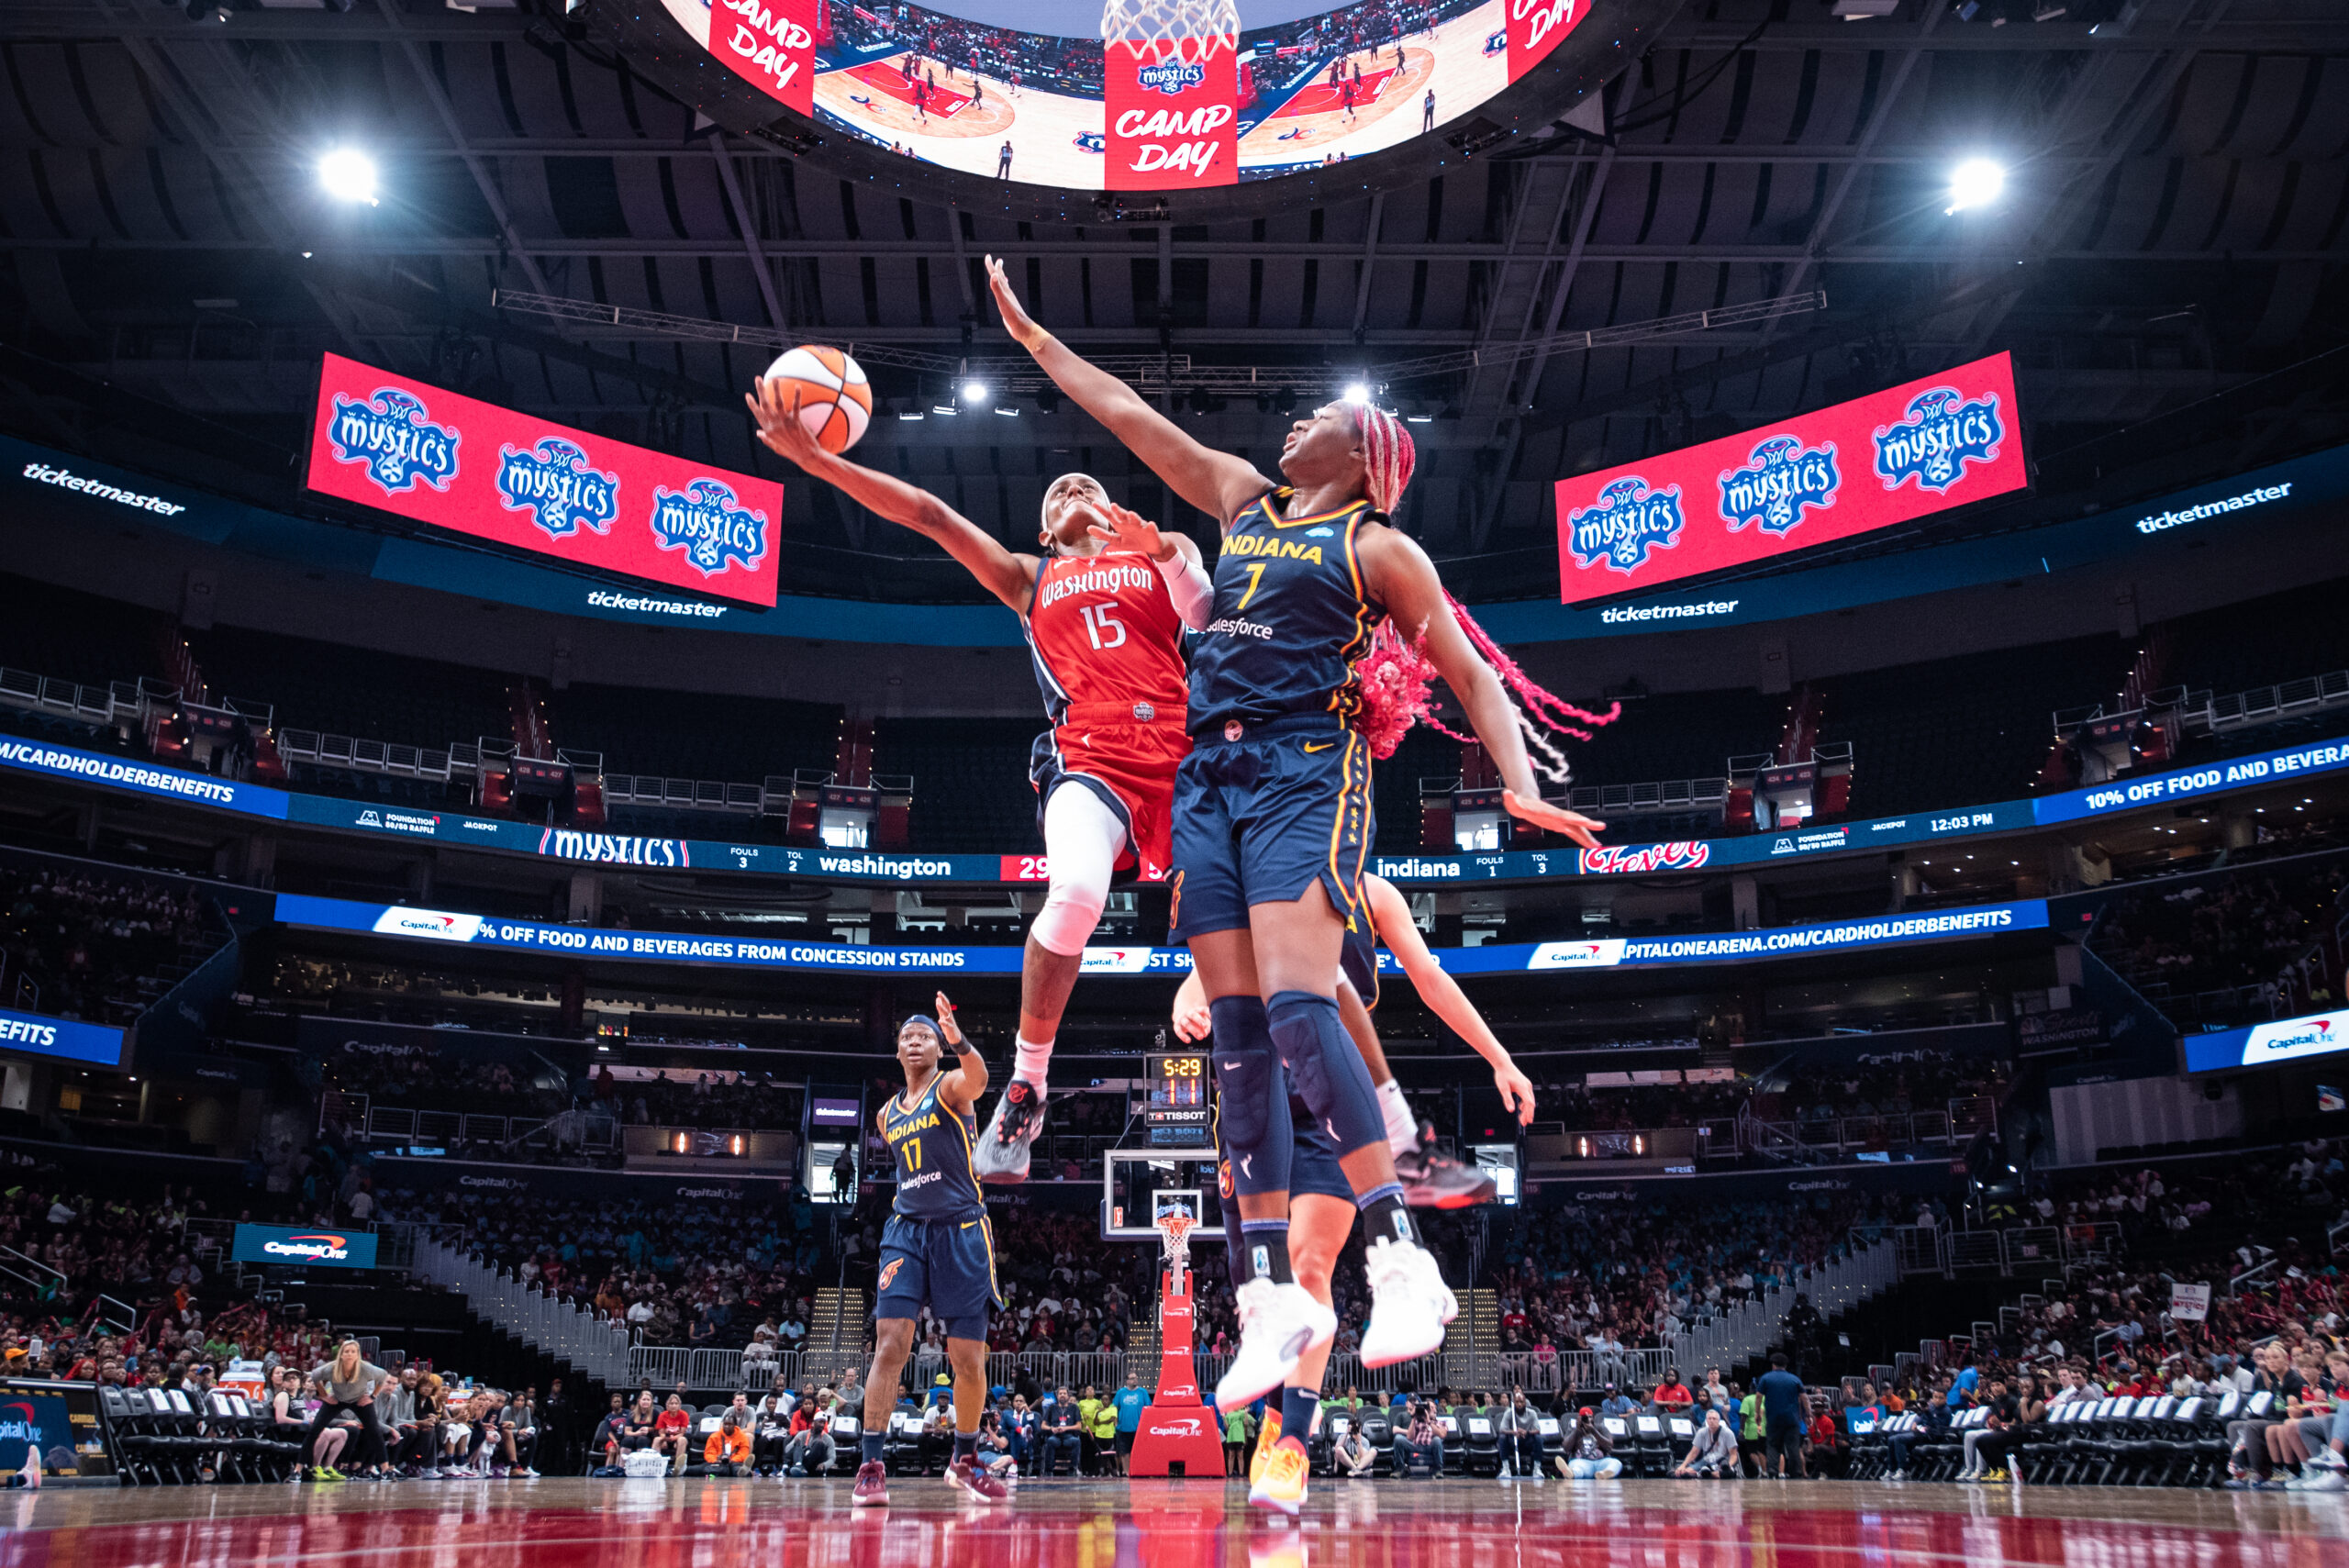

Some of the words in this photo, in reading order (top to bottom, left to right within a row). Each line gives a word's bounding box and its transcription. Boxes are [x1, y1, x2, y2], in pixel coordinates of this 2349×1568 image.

[728, 24, 799, 89] DAY
[1115, 105, 1232, 138] CAMP
[1129, 141, 1219, 177] DAY
[23, 462, 185, 517] ticketmaster
[2136, 482, 2292, 533] ticketmaster
[1237, 563, 1266, 609] 7
[587, 590, 727, 618] ticketmaster
[1601, 597, 1739, 624] ticketmaster
[1080, 602, 1127, 650] 15
[2086, 790, 2124, 809] 10%
[2128, 781, 2164, 801] OFF
[2168, 770, 2221, 794] FOOD
[2227, 761, 2268, 782] AND
[386, 814, 435, 826] FOUNDATION
[463, 821, 498, 832] JACKPOT
[1871, 820, 1906, 831] JACKPOT
[1931, 816, 1969, 832] 12:03
[1973, 813, 1993, 827] PM
[409, 826, 435, 834] RAFFLE
[1798, 831, 1844, 843] FOUNDATION
[730, 847, 758, 857] FOULS
[1820, 839, 1846, 848] RAFFLE
[739, 857, 748, 868] 3
[787, 851, 804, 860] TOL
[1476, 854, 1504, 865] FOULS
[1531, 854, 1549, 862] TOL
[788, 861, 797, 872] 2
[819, 854, 952, 877] washington
[1019, 857, 1050, 879] 29
[1377, 858, 1460, 878] indiana
[1489, 866, 1496, 877] 1
[1538, 863, 1547, 874] 3
[500, 926, 534, 942] OFF
[538, 930, 586, 948] FOOD
[591, 935, 629, 951] AND
[633, 938, 733, 958] BEVERAGES
[738, 944, 786, 961] FROM
[791, 947, 896, 966] CONCESSION
[900, 951, 964, 966] STANDS
[1163, 1059, 1201, 1076] 5:29
[1163, 1112, 1206, 1120] TISSOT
[901, 1138, 922, 1173] 17
[901, 1172, 941, 1190] salesforce
